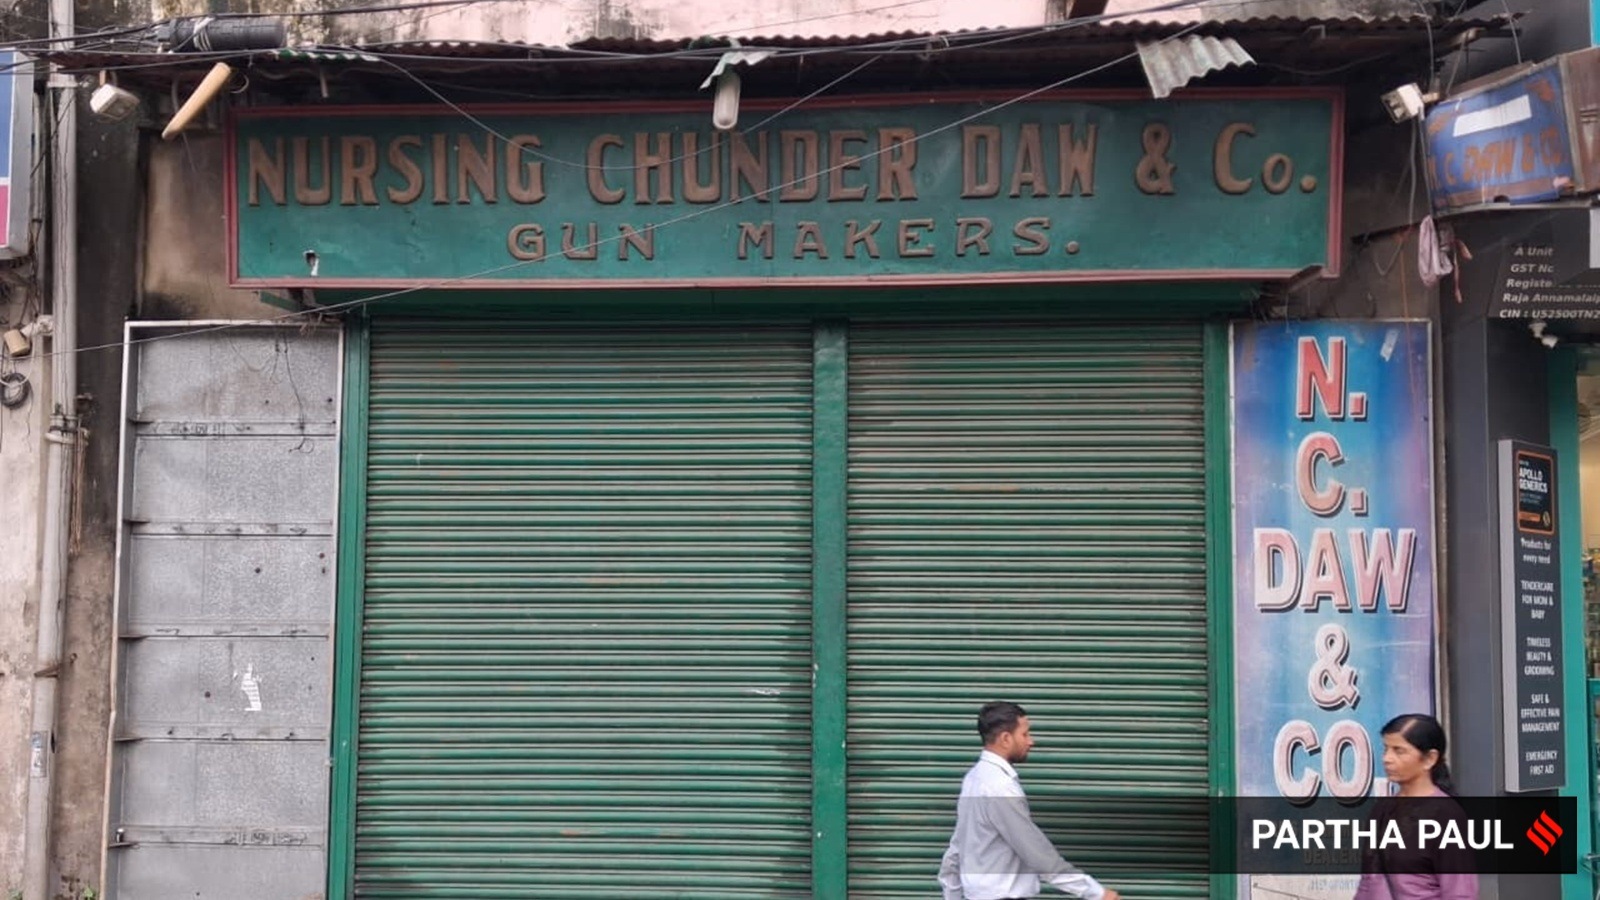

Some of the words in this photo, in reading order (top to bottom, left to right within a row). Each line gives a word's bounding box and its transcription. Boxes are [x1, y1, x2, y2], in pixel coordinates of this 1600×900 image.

[248, 133, 546, 206] NURSING
[587, 124, 918, 205] CHUNDER
[961, 122, 1097, 198] DAW
[1134, 122, 1176, 195] &
[1213, 122, 1317, 195] Co.
[507, 222, 656, 261] GUN
[738, 216, 1080, 259] MAKERS.
[1514, 247, 1524, 256] A
[1527, 247, 1553, 256] Unit
[1510, 263, 1537, 273] GST
[1505, 278, 1553, 290] Registe
[1502, 292, 1530, 304] Raja
[1499, 308, 1521, 319] CIN
[1295, 336, 1367, 421] N.
[1295, 431, 1367, 518] C.
[1519, 467, 1543, 482] APOLLO
[1519, 479, 1548, 493] GENERICS
[1520, 537, 1543, 550] Products
[1253, 527, 1416, 613] DAW
[1522, 594, 1532, 604] FOR
[1531, 609, 1545, 619] BABY
[1526, 651, 1546, 661] BEAUTY
[1308, 623, 1358, 711] &
[1524, 665, 1555, 676] GROOMING
[1531, 693, 1544, 704] SAFE
[1520, 708, 1547, 718] EFFECTIVE
[1521, 721, 1560, 732] MANAGEMENT
[1525, 750, 1557, 761] EMERGENCY
[1530, 764, 1543, 775] FIRST
[1544, 764, 1555, 774] AID
